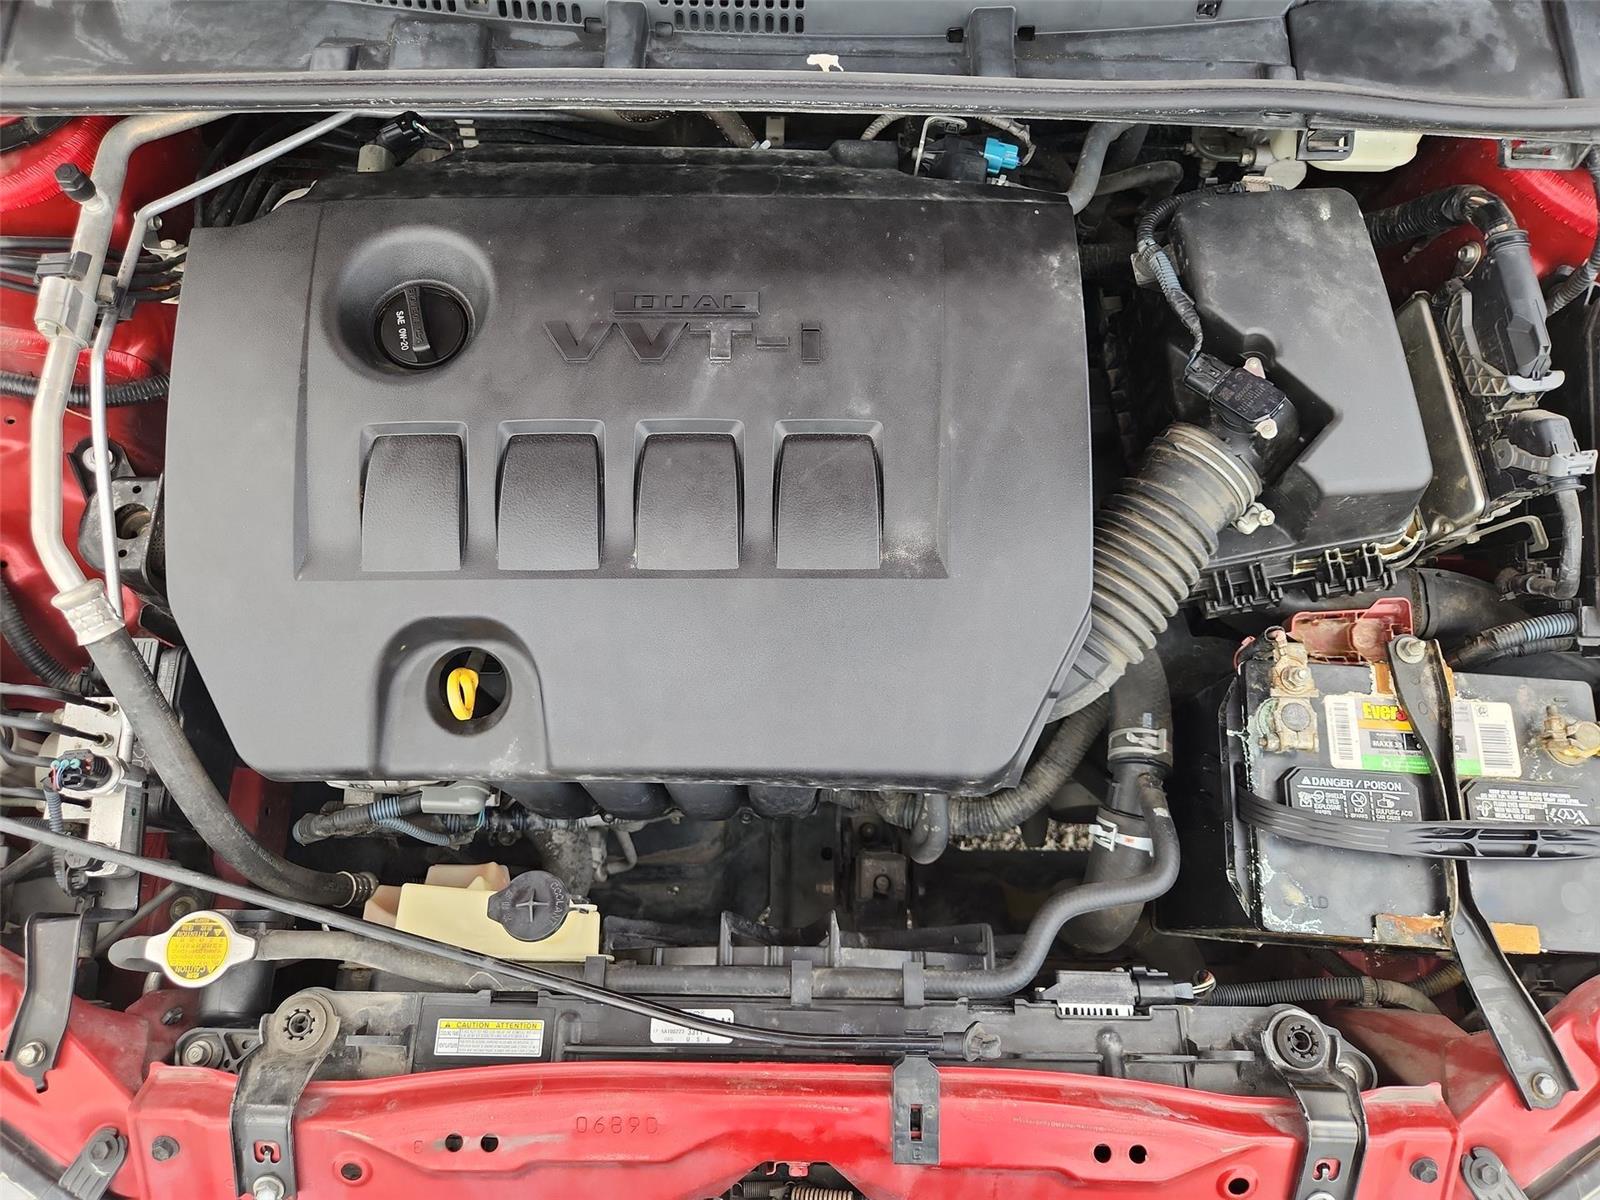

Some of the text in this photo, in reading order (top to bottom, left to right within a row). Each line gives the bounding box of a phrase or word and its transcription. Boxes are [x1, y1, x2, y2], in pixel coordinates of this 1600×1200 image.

[633, 295, 746, 308] DUAL
[396, 310, 405, 325] SAE
[1311, 777, 1354, 788] DANGER
[1364, 780, 1402, 791] POISON
[550, 881, 564, 927] COOLANT
